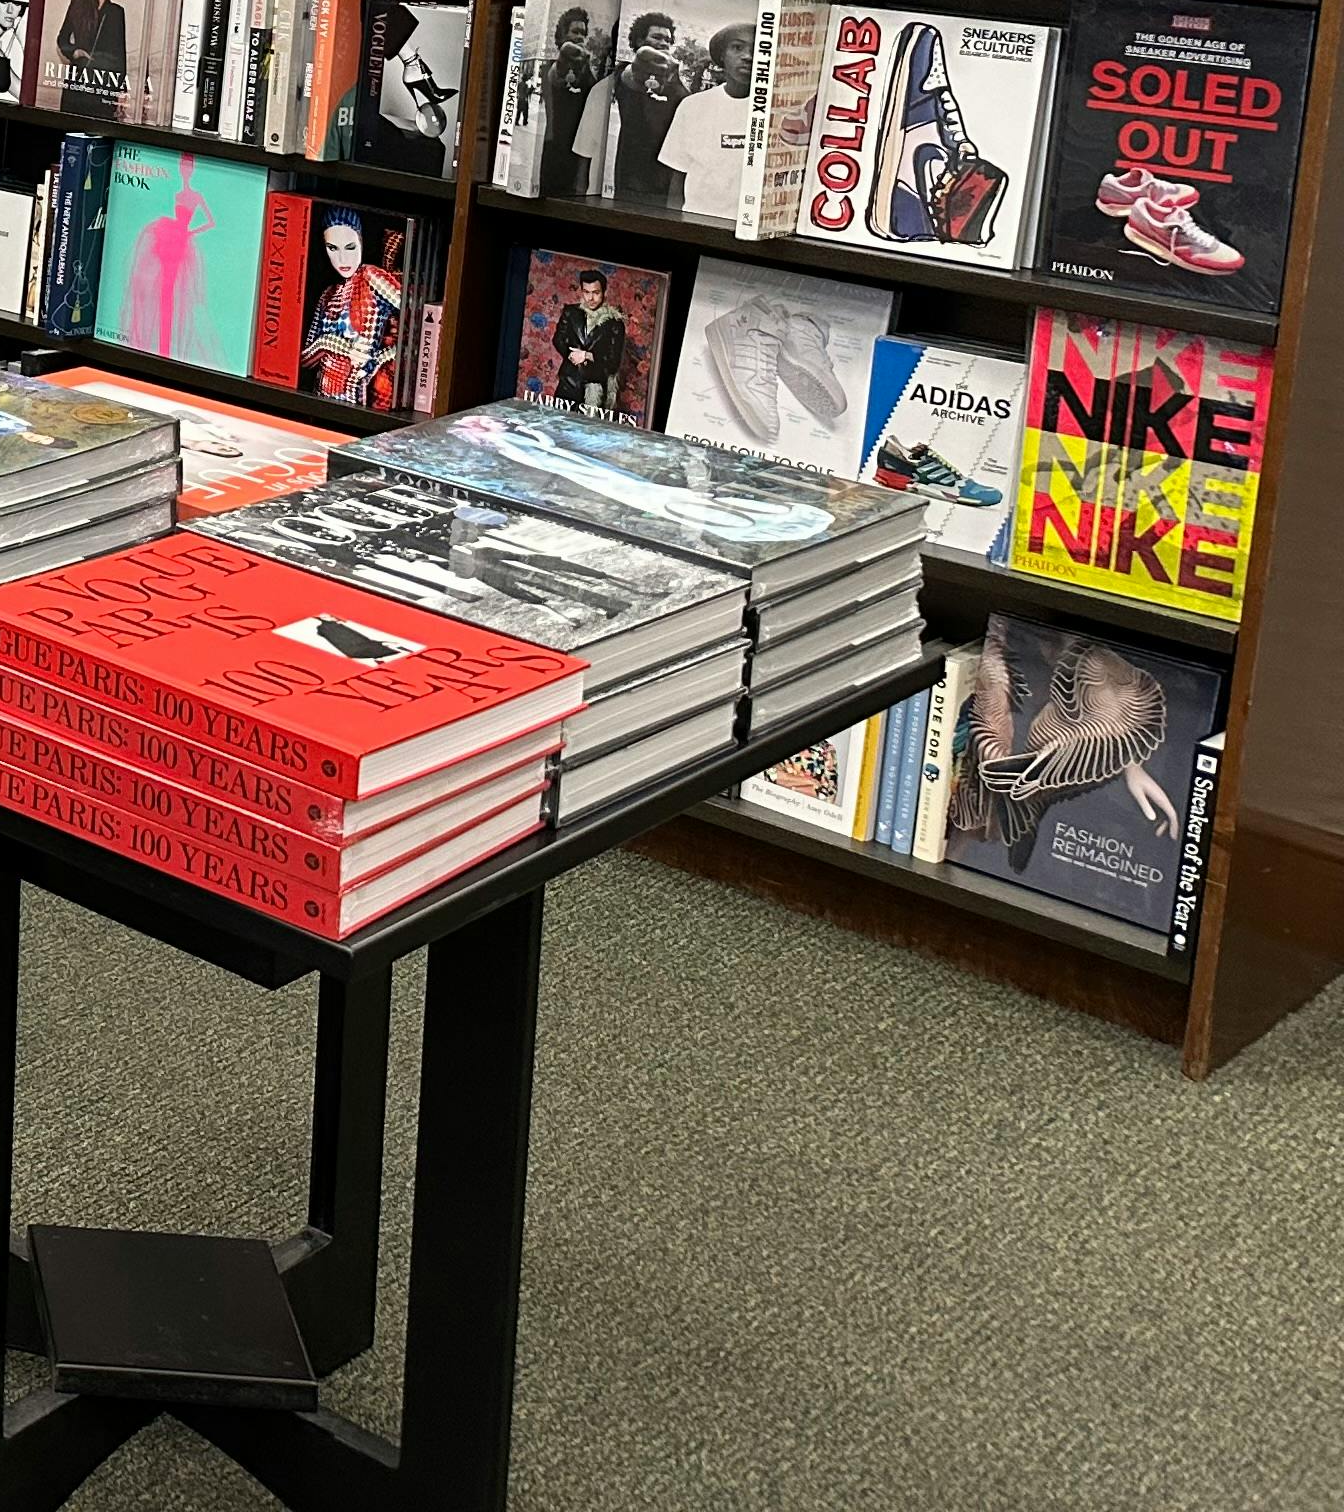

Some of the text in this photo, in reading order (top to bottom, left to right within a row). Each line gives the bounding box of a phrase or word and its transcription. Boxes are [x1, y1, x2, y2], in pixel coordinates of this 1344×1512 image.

[960, 41, 1034, 57] X CULTURE
[962, 25, 1037, 51] SNEAKERS
[44, 61, 133, 91] RIHANNA
[1086, 59, 1283, 119] SOLED
[810, 15, 882, 233] COLLAB
[115, 145, 142, 162] THE
[1117, 119, 1235, 175] OUT
[114, 172, 151, 192] BOOK
[115, 158, 170, 179] FASHION
[1051, 259, 1114, 283] PHAIDON
[908, 382, 1012, 421] ADIDAS
[929, 407, 987, 428] ARCHIVE
[1043, 369, 1256, 470] NIKE
[1028, 490, 1240, 598] NIKE
[58, 652, 145, 706] PARIS:
[153, 686, 194, 728] 100
[200, 708, 308, 773] YEARS
[42, 695, 130, 748] PARIS:
[136, 728, 179, 770] 100
[184, 752, 292, 816] YEARS
[1054, 821, 1134, 857] FASHION
[1174, 775, 1214, 932] Sneaker of the Year
[1051, 839, 1165, 887] REIMAGINED
